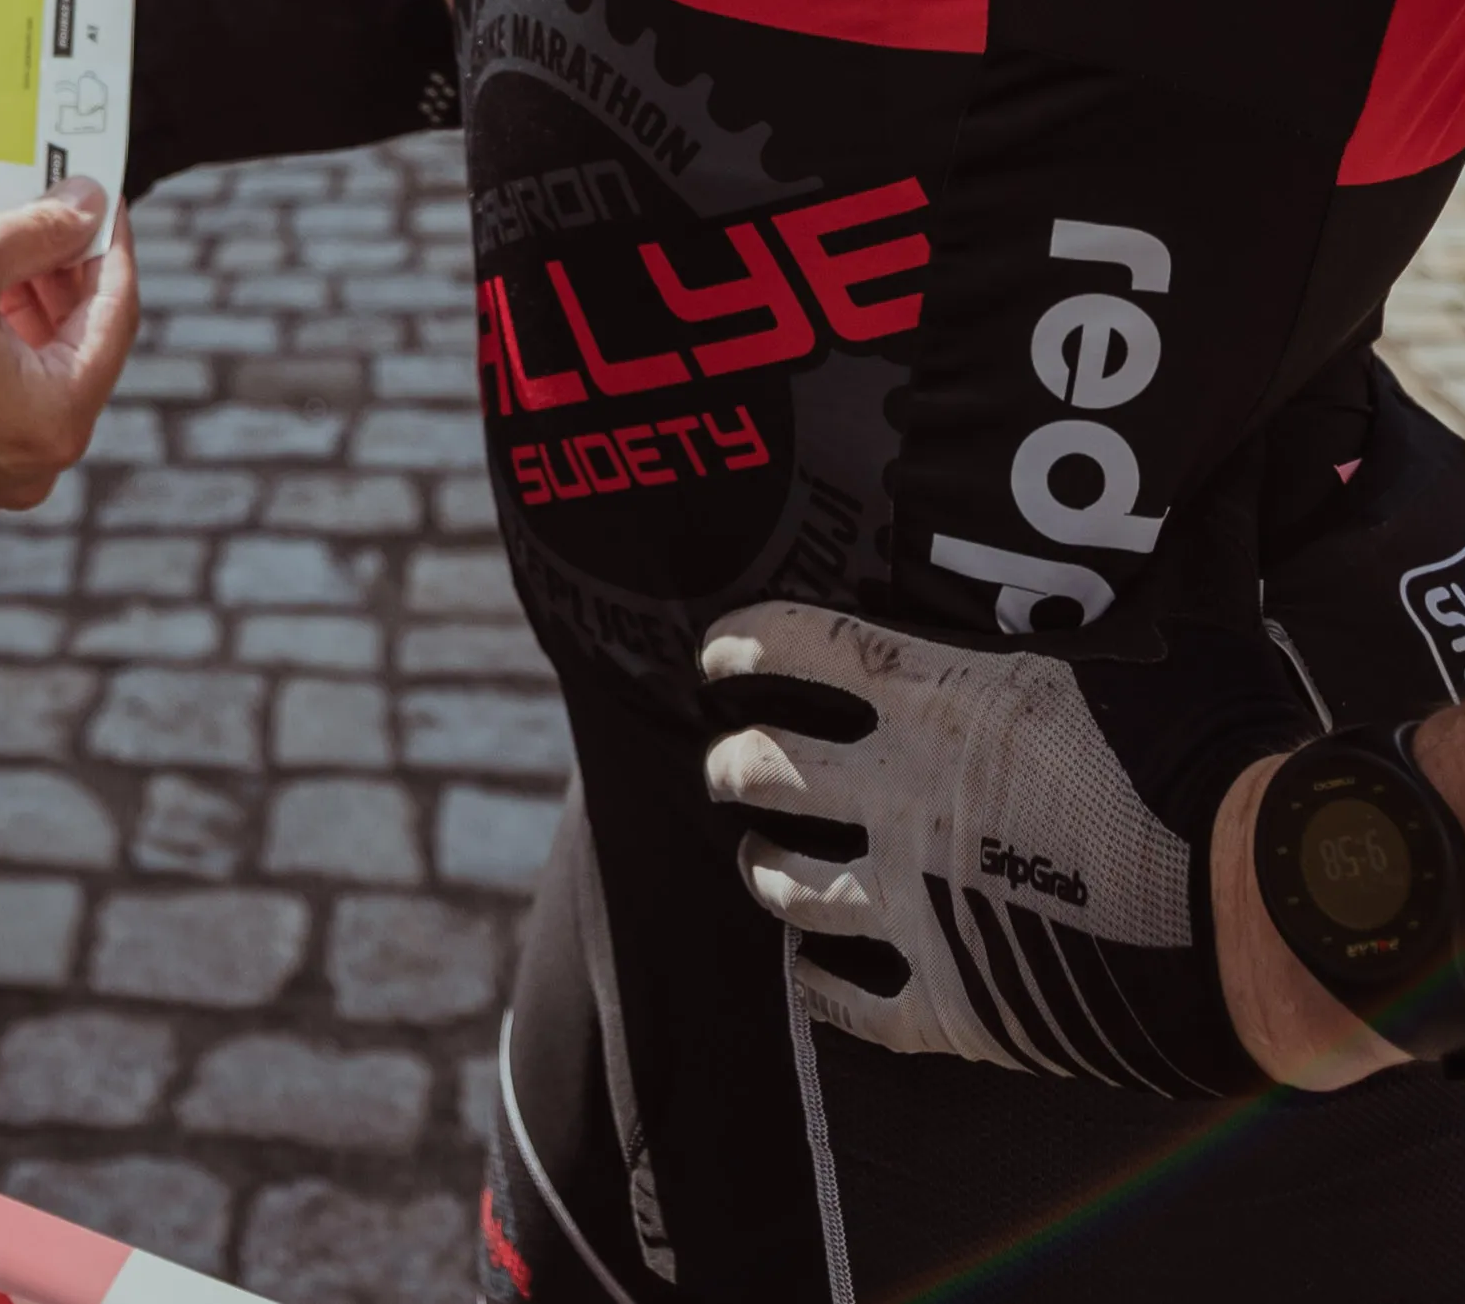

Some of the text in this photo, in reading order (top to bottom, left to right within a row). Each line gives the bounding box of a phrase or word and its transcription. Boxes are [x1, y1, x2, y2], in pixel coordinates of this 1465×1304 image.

[512, 13, 702, 177] MARATHON
[477, 176, 932, 418] ALLYE
[512, 406, 771, 506] SUDETY
[980, 836, 1088, 907] GripGrab
